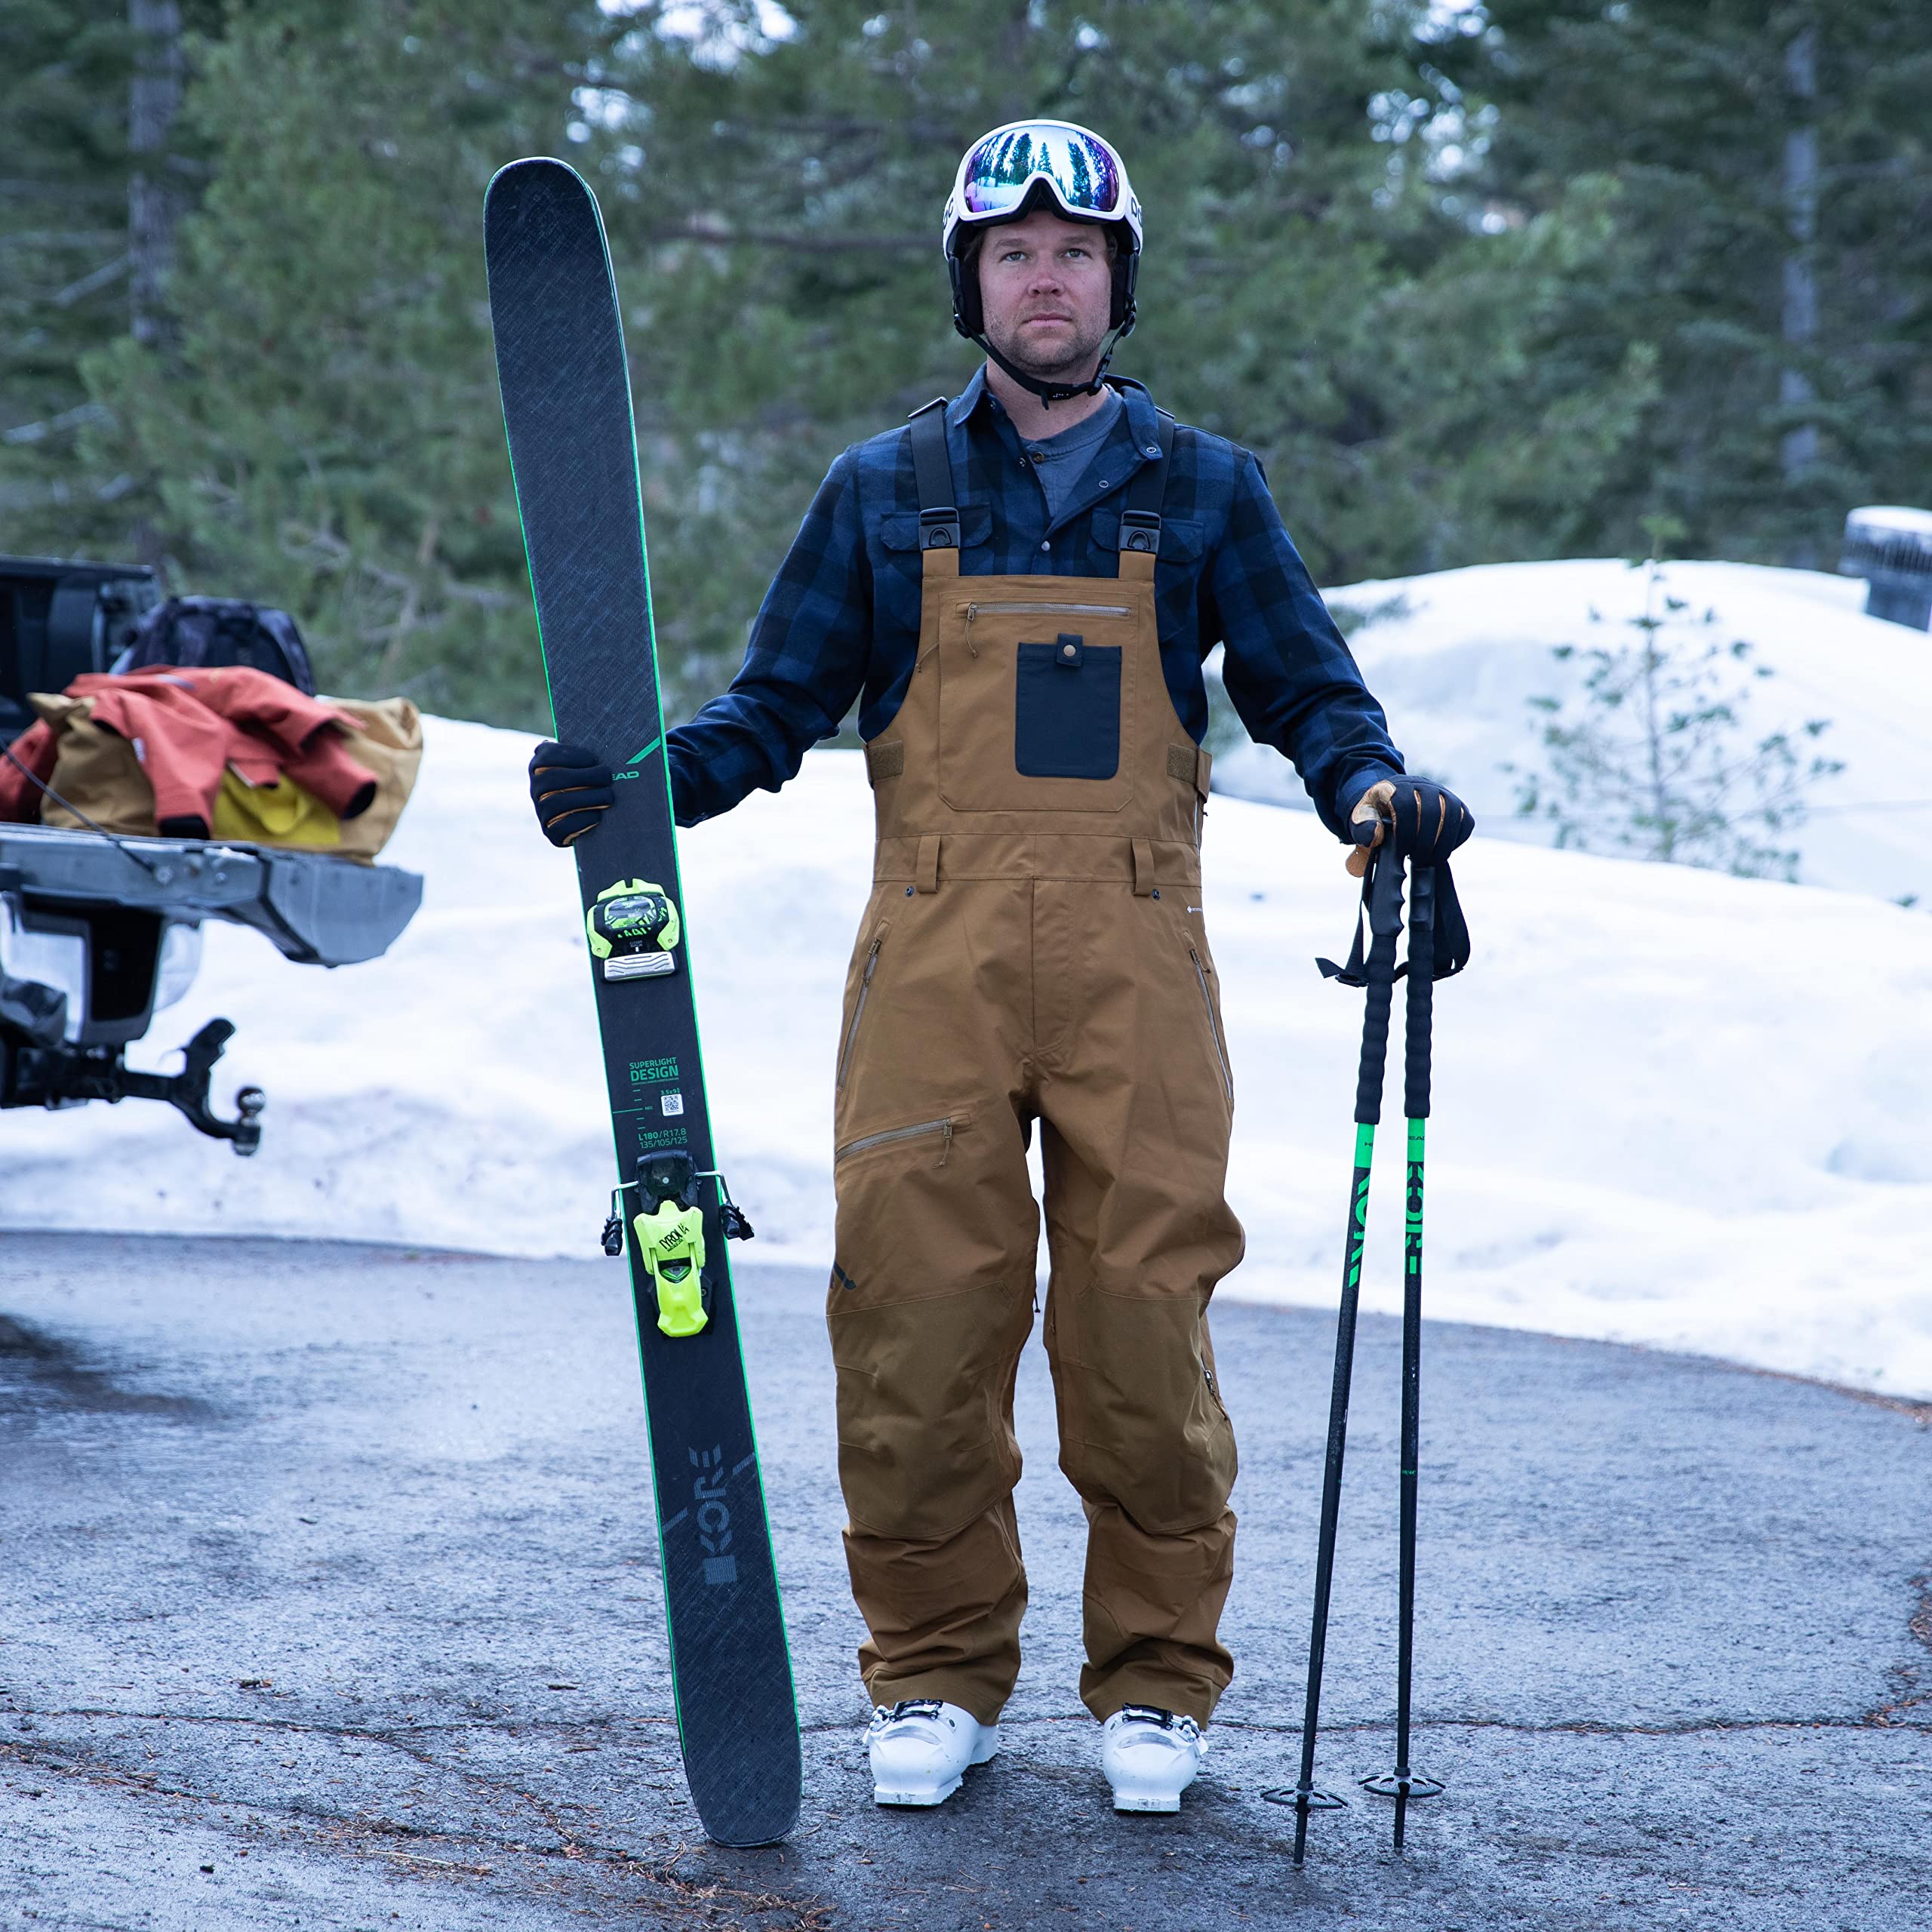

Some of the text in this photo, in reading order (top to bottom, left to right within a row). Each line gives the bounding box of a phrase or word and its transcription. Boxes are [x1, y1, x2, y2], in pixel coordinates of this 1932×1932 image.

[612, 771, 639, 781] AD
[629, 1057, 677, 1069] SUPERLIGHT
[630, 1065, 679, 1081] DESIGN
[638, 1128, 687, 1141] L180/R17.8
[640, 1136, 688, 1149] 135/105/125
[688, 1443, 737, 1585] KORE
